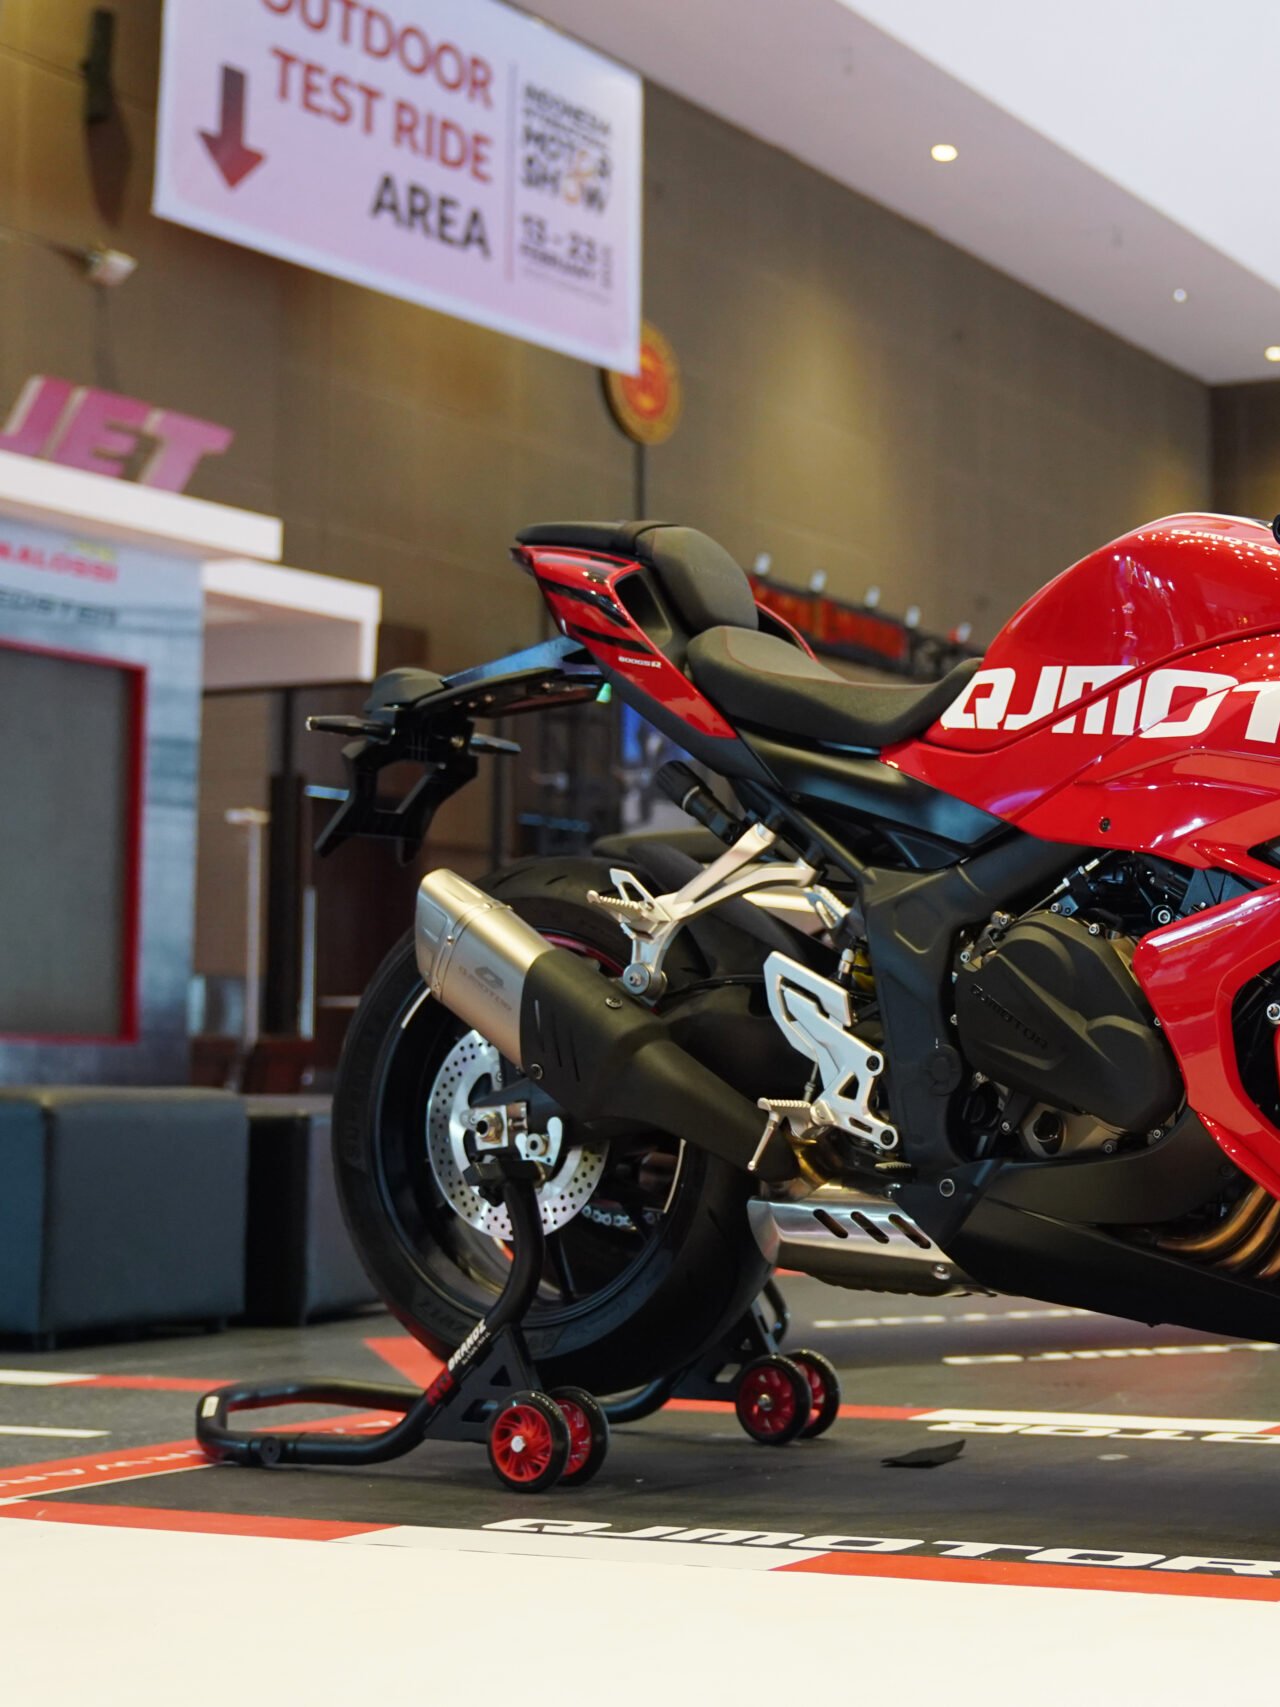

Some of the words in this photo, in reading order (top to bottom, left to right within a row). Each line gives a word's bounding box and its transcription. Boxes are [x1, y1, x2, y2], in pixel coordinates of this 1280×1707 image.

[271, 46, 383, 134] TEST
[394, 100, 492, 183] RIDE
[370, 173, 491, 260] AREA
